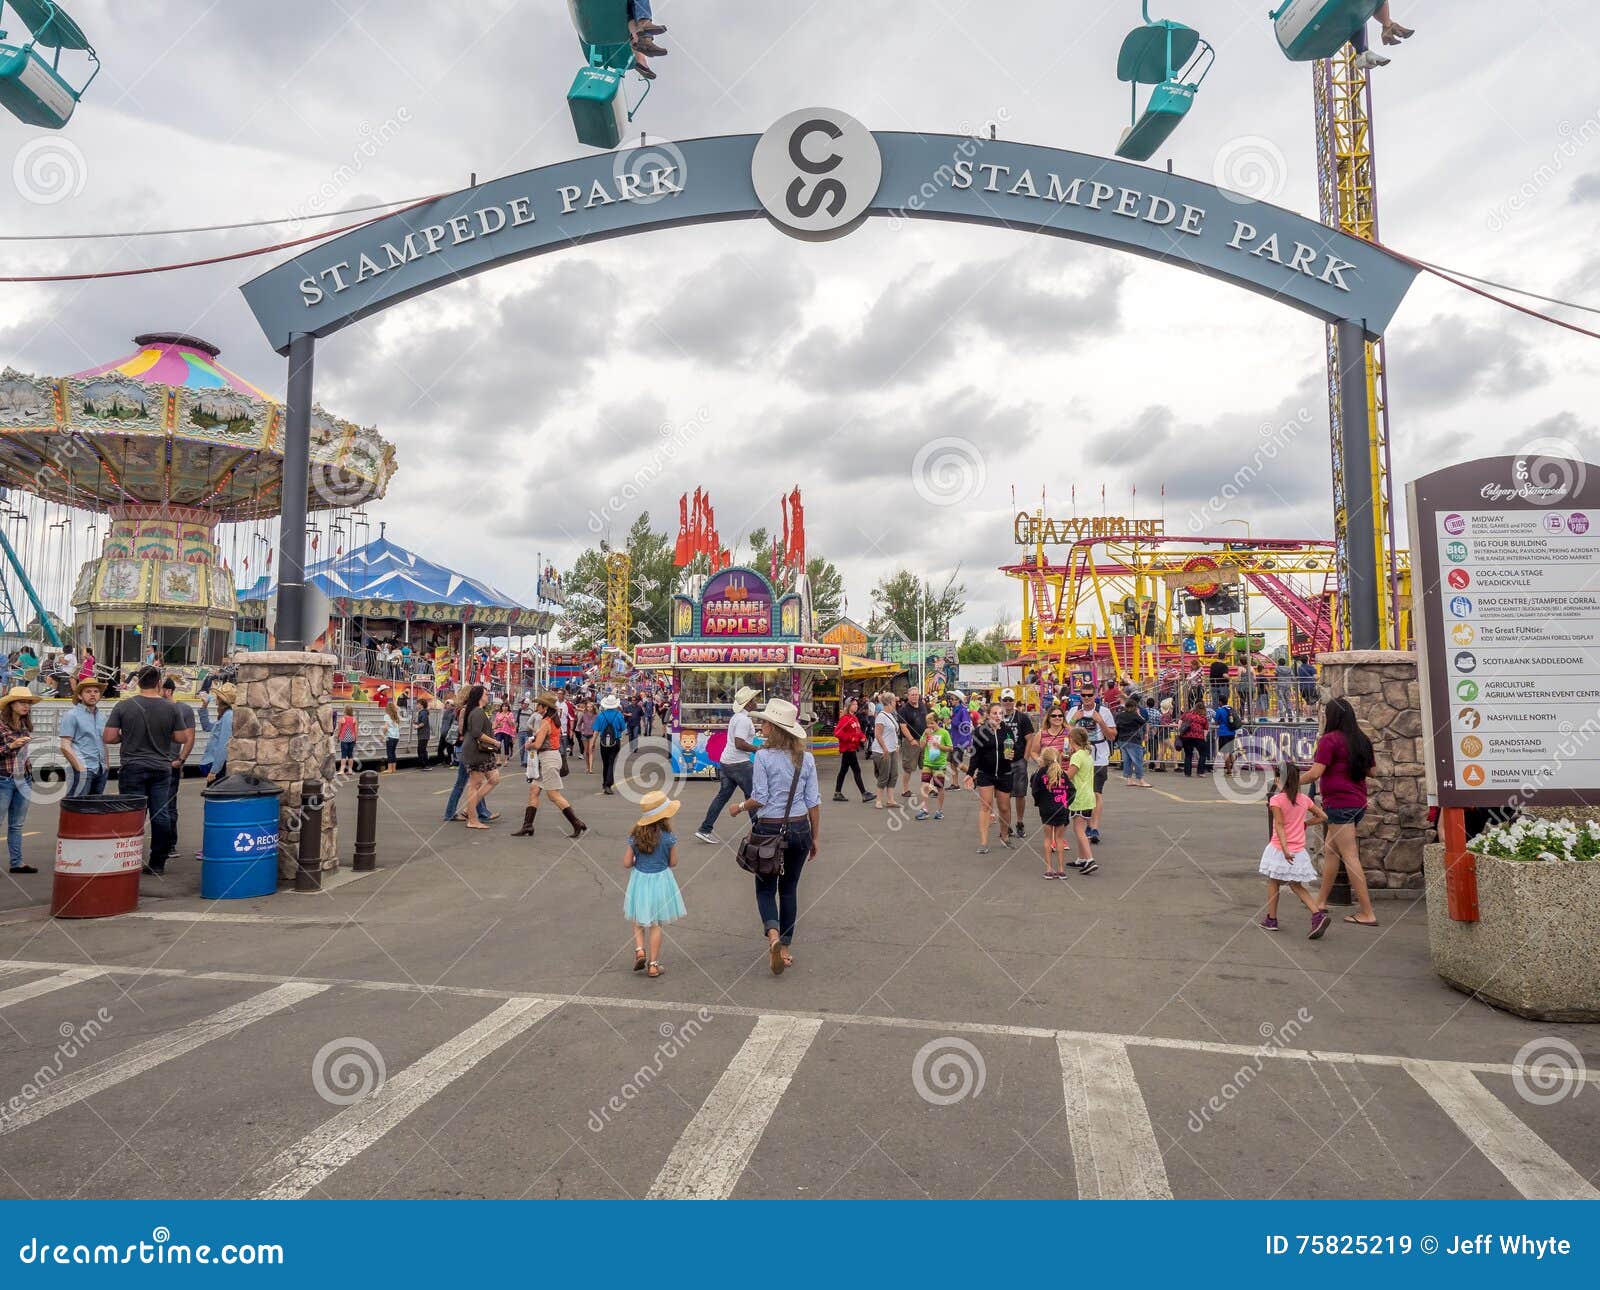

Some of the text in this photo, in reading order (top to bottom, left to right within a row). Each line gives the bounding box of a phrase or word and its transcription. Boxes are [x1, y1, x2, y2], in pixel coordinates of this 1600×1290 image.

[952, 160, 1357, 292] STAMPEDE PARK
[299, 167, 684, 307] STAMPEDE PARK
[1480, 482, 1519, 501] Calgary
[1015, 511, 1165, 544] CRAZY MOUSE
[706, 600, 767, 616] CARAMEL
[705, 617, 769, 634] APPLES
[637, 655, 669, 664] DRINKS
[641, 648, 667, 656] COLD
[679, 647, 786, 663] CANDY APPLES
[801, 647, 831, 656] COLD
[796, 655, 837, 665] DRINKS
[1443, 780, 1453, 788] #4
[257, 833, 280, 845] RECYC
